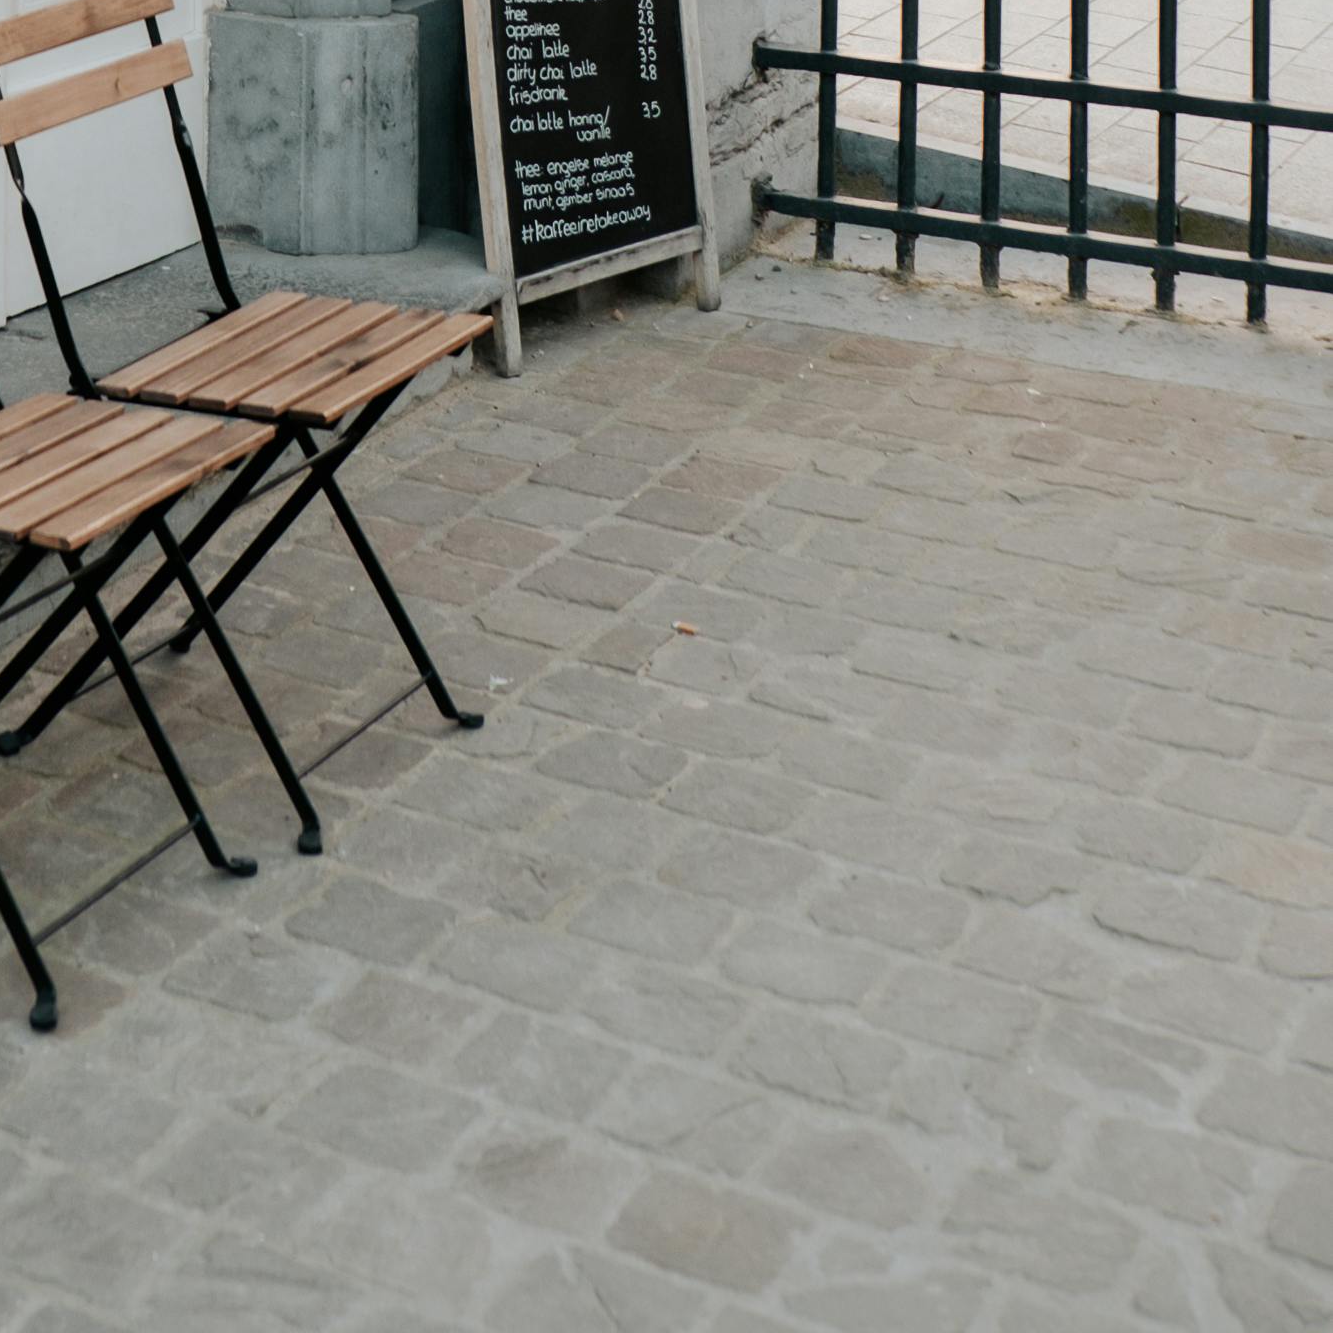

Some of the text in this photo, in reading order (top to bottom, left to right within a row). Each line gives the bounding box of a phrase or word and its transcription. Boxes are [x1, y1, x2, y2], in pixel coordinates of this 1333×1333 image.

[504, 5, 528, 22] thee
[505, 22, 561, 42] appelthee
[506, 41, 533, 61] chai
[541, 38, 570, 59] latte
[506, 61, 536, 86] dirty
[539, 63, 565, 81] chai
[569, 58, 598, 79] latte
[509, 84, 569, 106] frisdrank
[509, 114, 535, 133] chai
[536, 110, 564, 131] latte
[546, 158, 590, 178] engelse
[593, 151, 634, 169] melange
[521, 181, 553, 196] lemon
[555, 192, 593, 211] gember
[595, 182, 635, 201] sinaas
